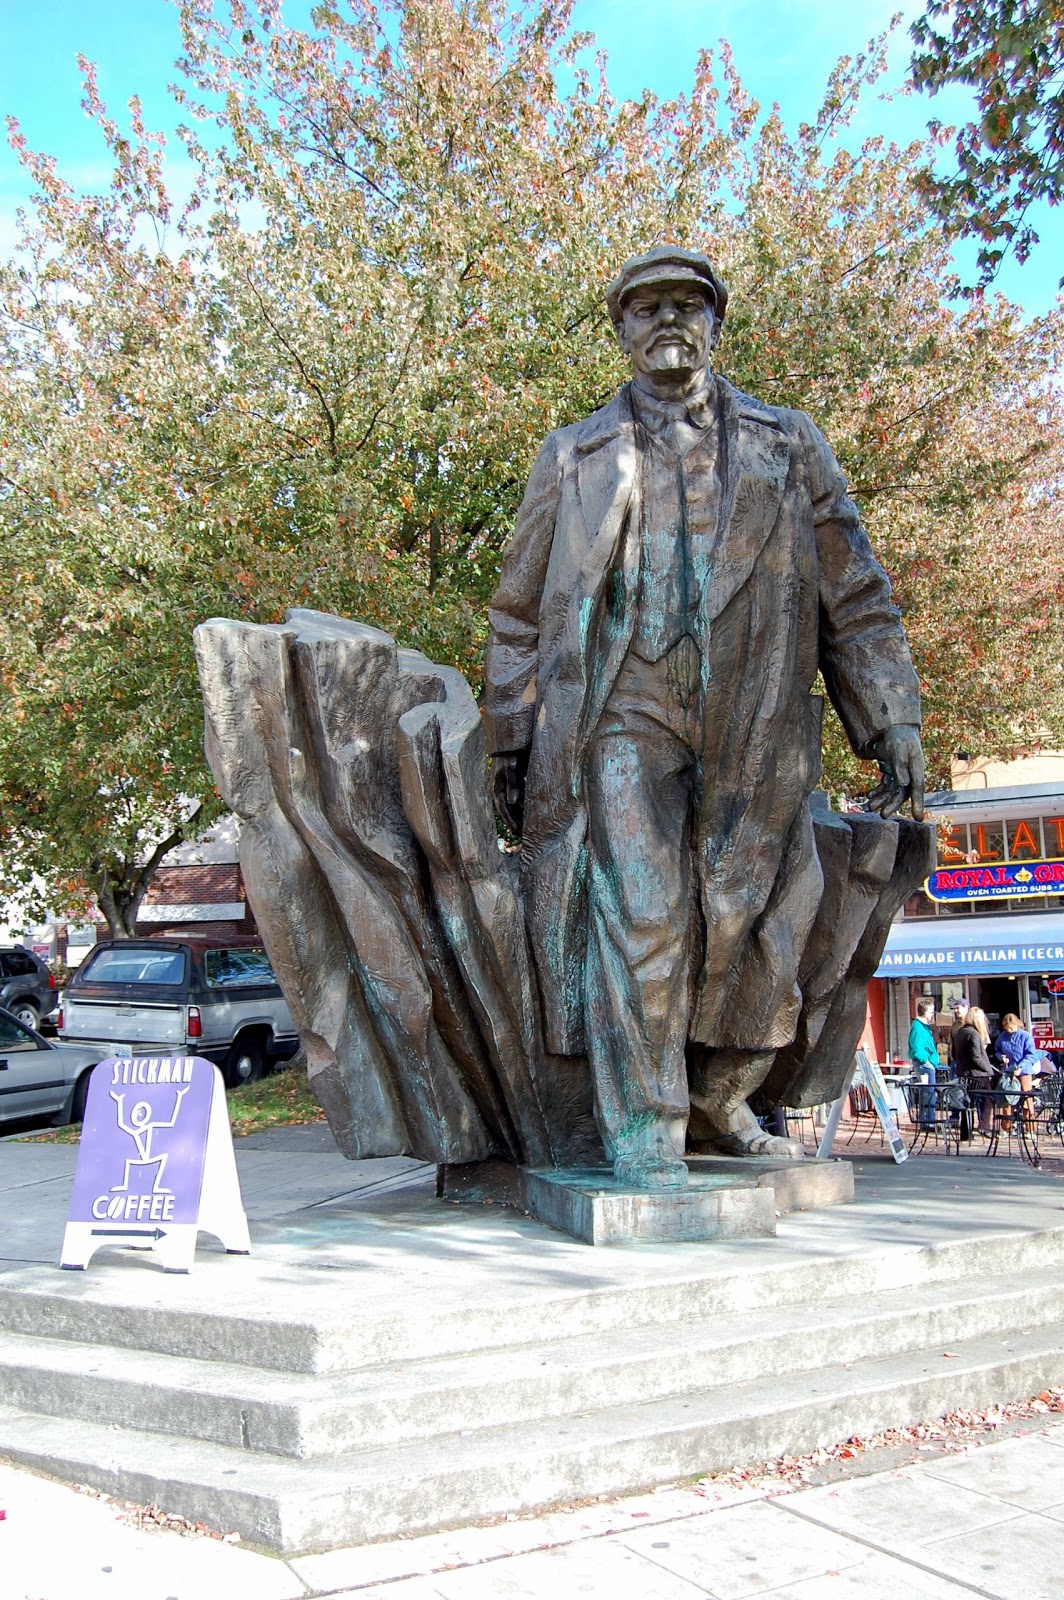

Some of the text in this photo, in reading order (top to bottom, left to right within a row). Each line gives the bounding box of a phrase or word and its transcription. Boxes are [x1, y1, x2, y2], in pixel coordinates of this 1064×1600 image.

[936, 864, 1064, 889] ROYAL GR
[967, 888, 989, 896] OVEN
[991, 885, 1028, 895] TOASTED
[1030, 884, 1052, 892] SUBS
[961, 950, 1017, 962] ITALIAN
[1022, 947, 1064, 960] ICECR
[111, 1058, 194, 1084] STICKMAN
[91, 1195, 175, 1221] COFFEE
